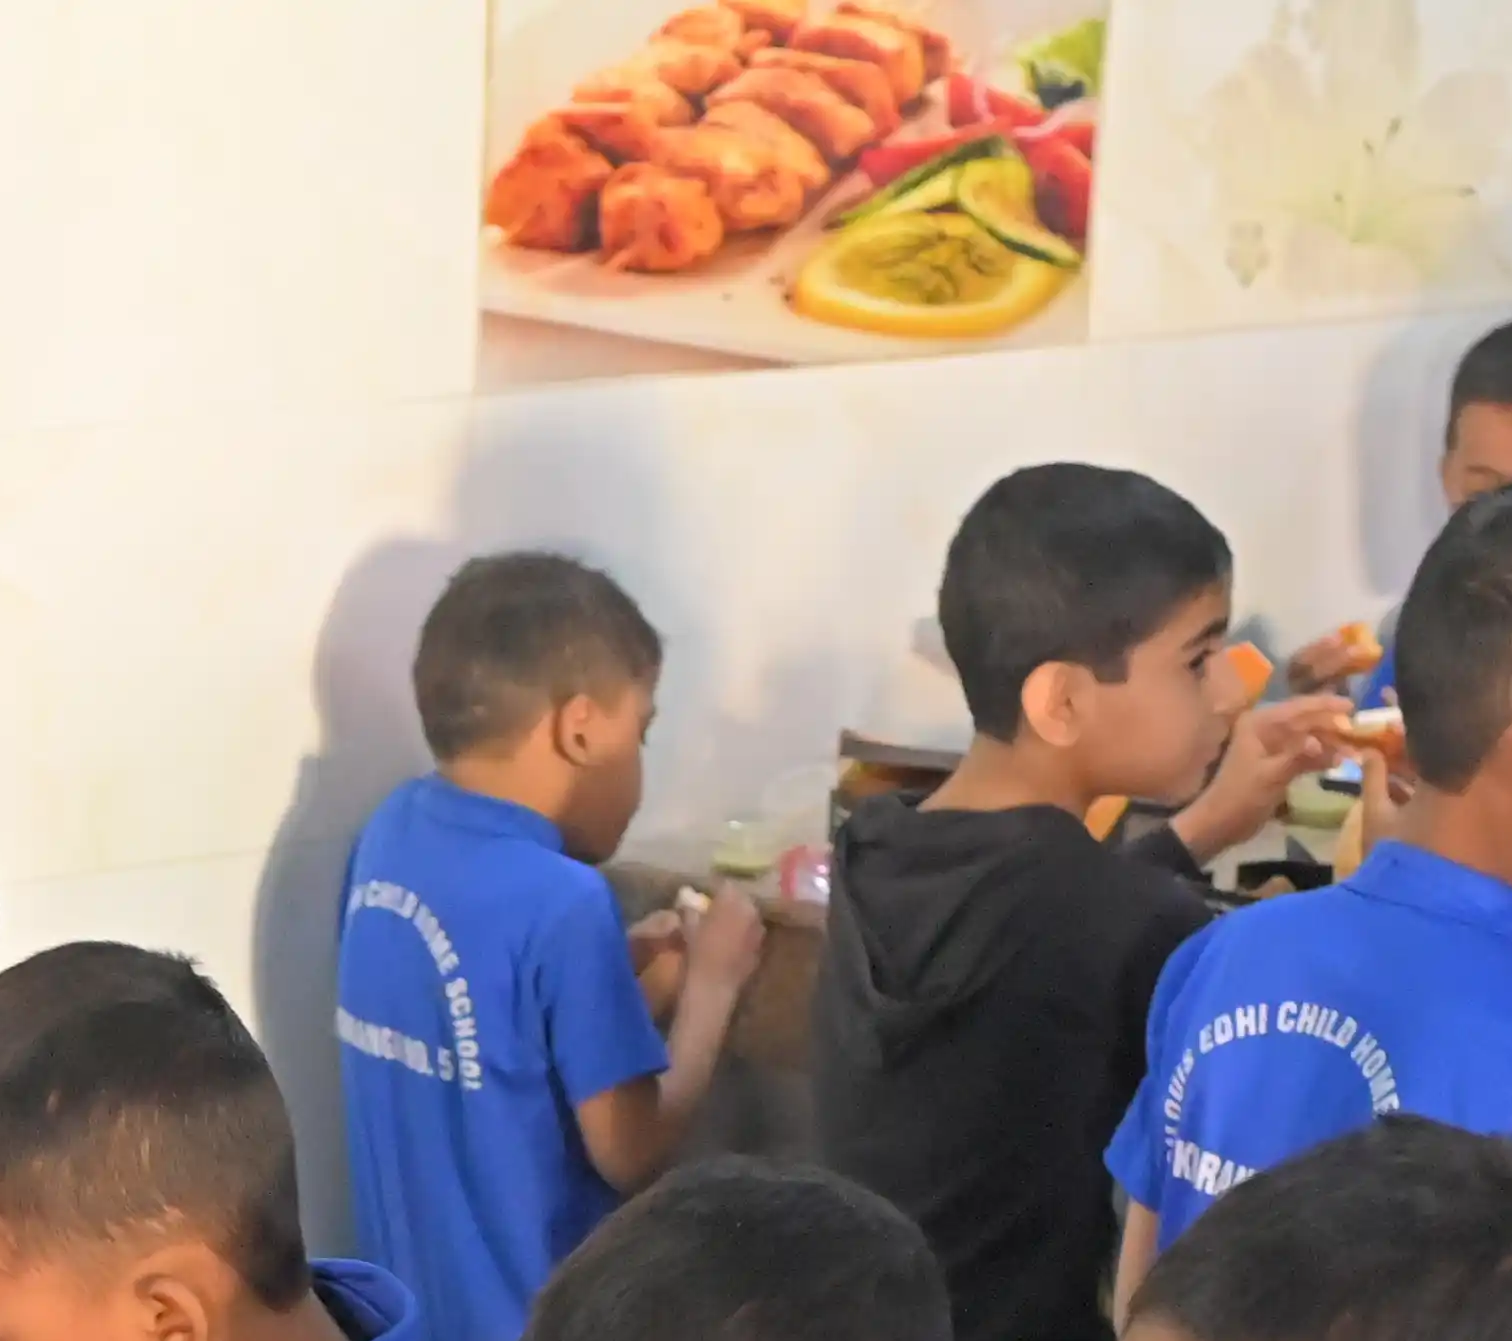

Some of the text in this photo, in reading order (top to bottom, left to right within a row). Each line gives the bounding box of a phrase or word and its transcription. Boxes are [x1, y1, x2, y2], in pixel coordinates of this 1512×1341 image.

[445, 977, 482, 1090] SCHOOL
[1199, 1003, 1268, 1054] EDHI
[1276, 1001, 1357, 1048] CHILD
